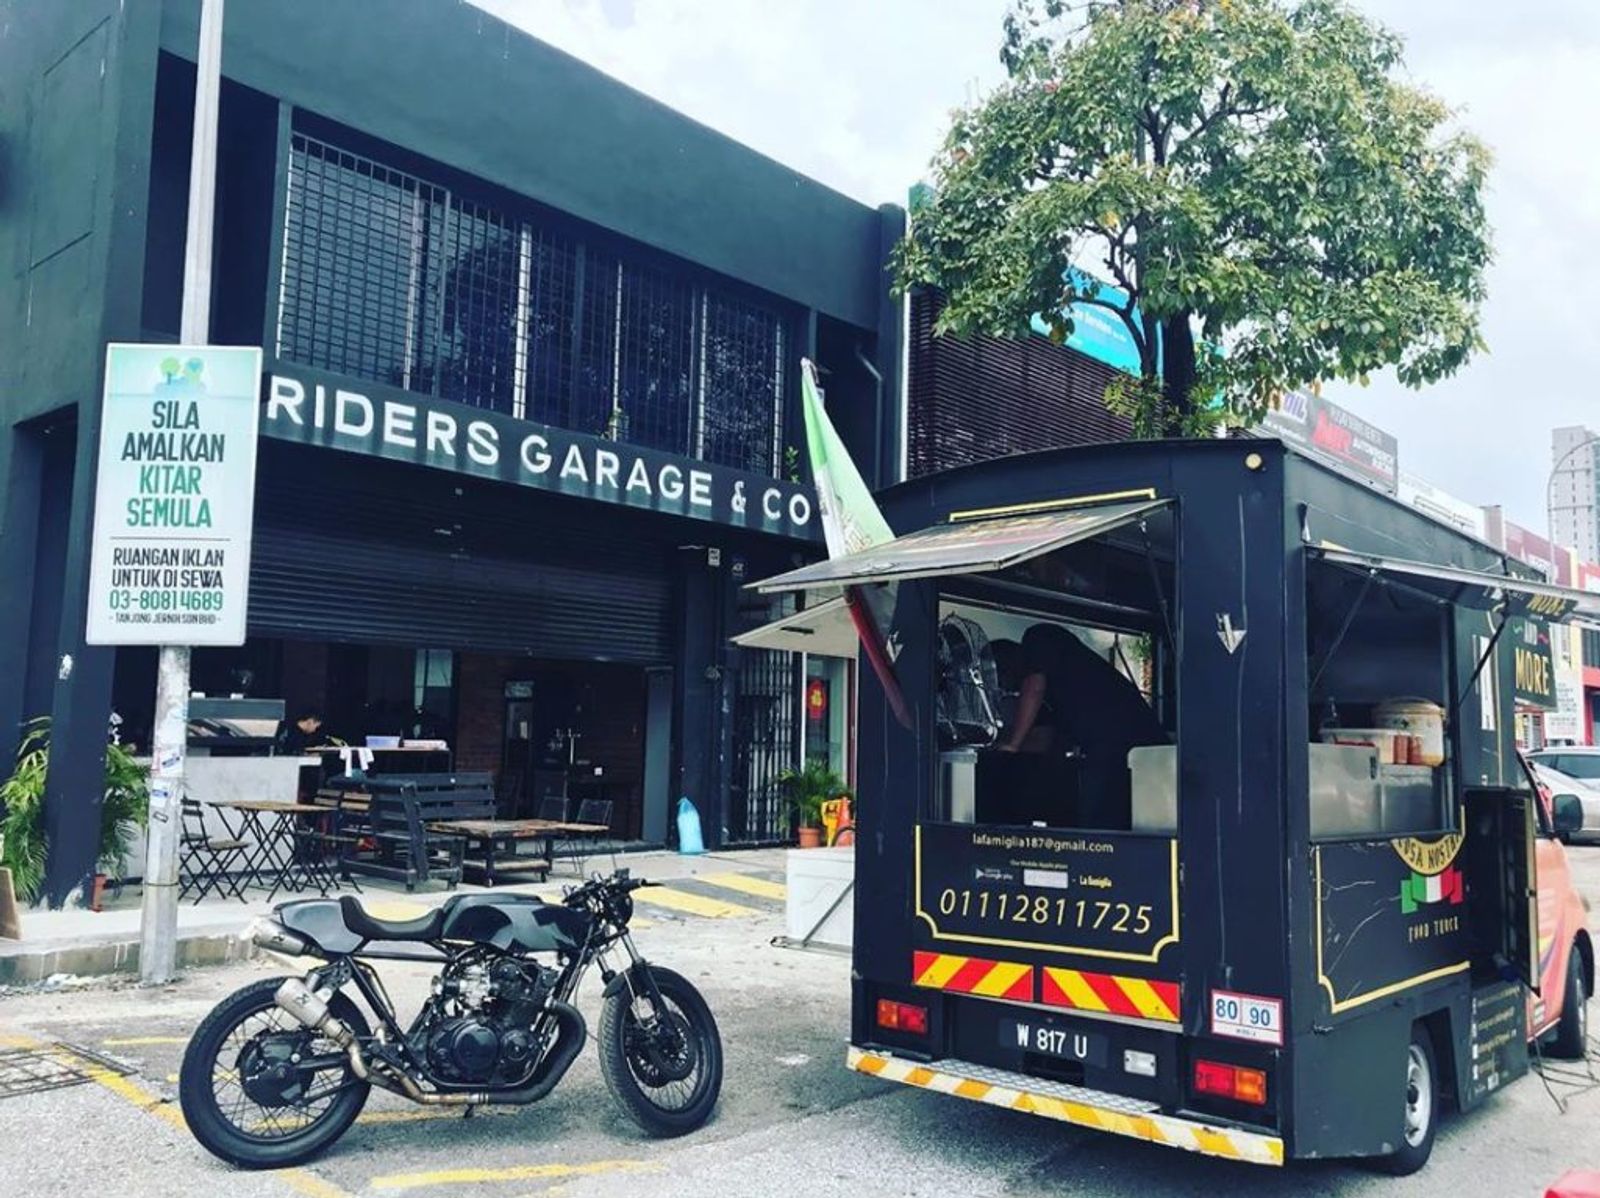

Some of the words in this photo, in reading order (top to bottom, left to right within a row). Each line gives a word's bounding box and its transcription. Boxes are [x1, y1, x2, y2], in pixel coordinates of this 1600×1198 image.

[151, 400, 200, 430] SILA
[121, 432, 225, 463] AMALKAN
[266, 374, 499, 466] RIDERS
[520, 434, 713, 507] GARAGE
[731, 480, 747, 514] &
[762, 487, 811, 525] CO
[139, 464, 201, 495] KITAR
[126, 498, 212, 528] SEMULA
[113, 547, 180, 567] RUANGAN
[182, 548, 225, 567] IKLAN
[112, 568, 161, 588] UNTUK
[163, 568, 178, 588] DI
[180, 569, 224, 589] SEWA
[1514, 647, 1550, 696] MORE
[972, 832, 1114, 854] lafamiglia187@gmail.com
[940, 888, 1153, 934] 01112811725
[1215, 998, 1238, 1020] 80
[1249, 1006, 1271, 1026] 90
[1016, 1023, 1030, 1047] W
[1036, 1027, 1067, 1053] 817
[1074, 1035, 1088, 1058] U
